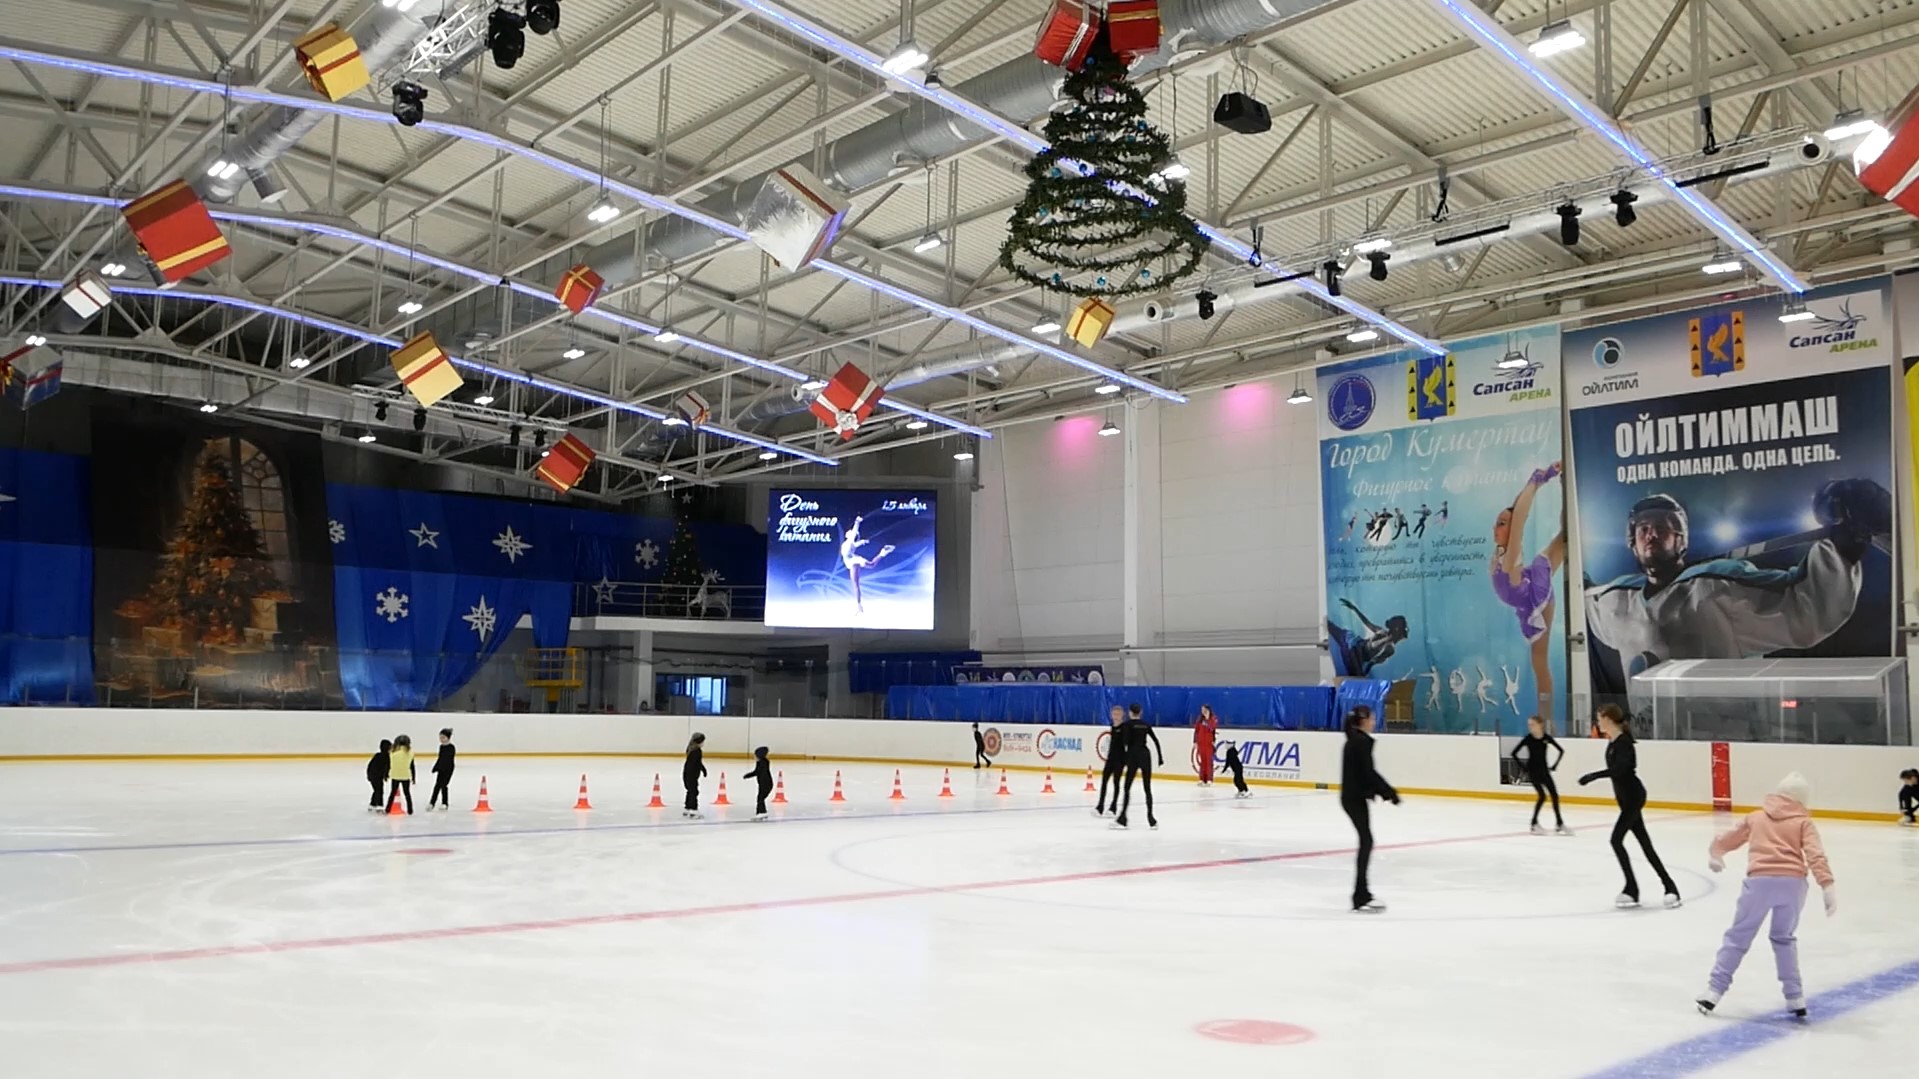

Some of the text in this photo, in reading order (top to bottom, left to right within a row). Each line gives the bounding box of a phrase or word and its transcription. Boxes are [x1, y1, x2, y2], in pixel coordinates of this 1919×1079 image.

[1789, 330, 1856, 348] Сапсан
[1829, 338, 1878, 353] АРЕНА
[1473, 379, 1535, 396] Сапсан
[1509, 388, 1552, 402] АРЕНА
[1582, 378, 1639, 396] ОЙЛТИМ
[1615, 396, 1839, 458] ОЙЛТИММАШ
[1330, 420, 1553, 478] Город Кумертау
[1617, 443, 1841, 484] ОДНА КОМАНДА. ОДНА ЦЕЛЬ.
[1353, 477, 1433, 504] Фигурное
[780, 493, 819, 512] День
